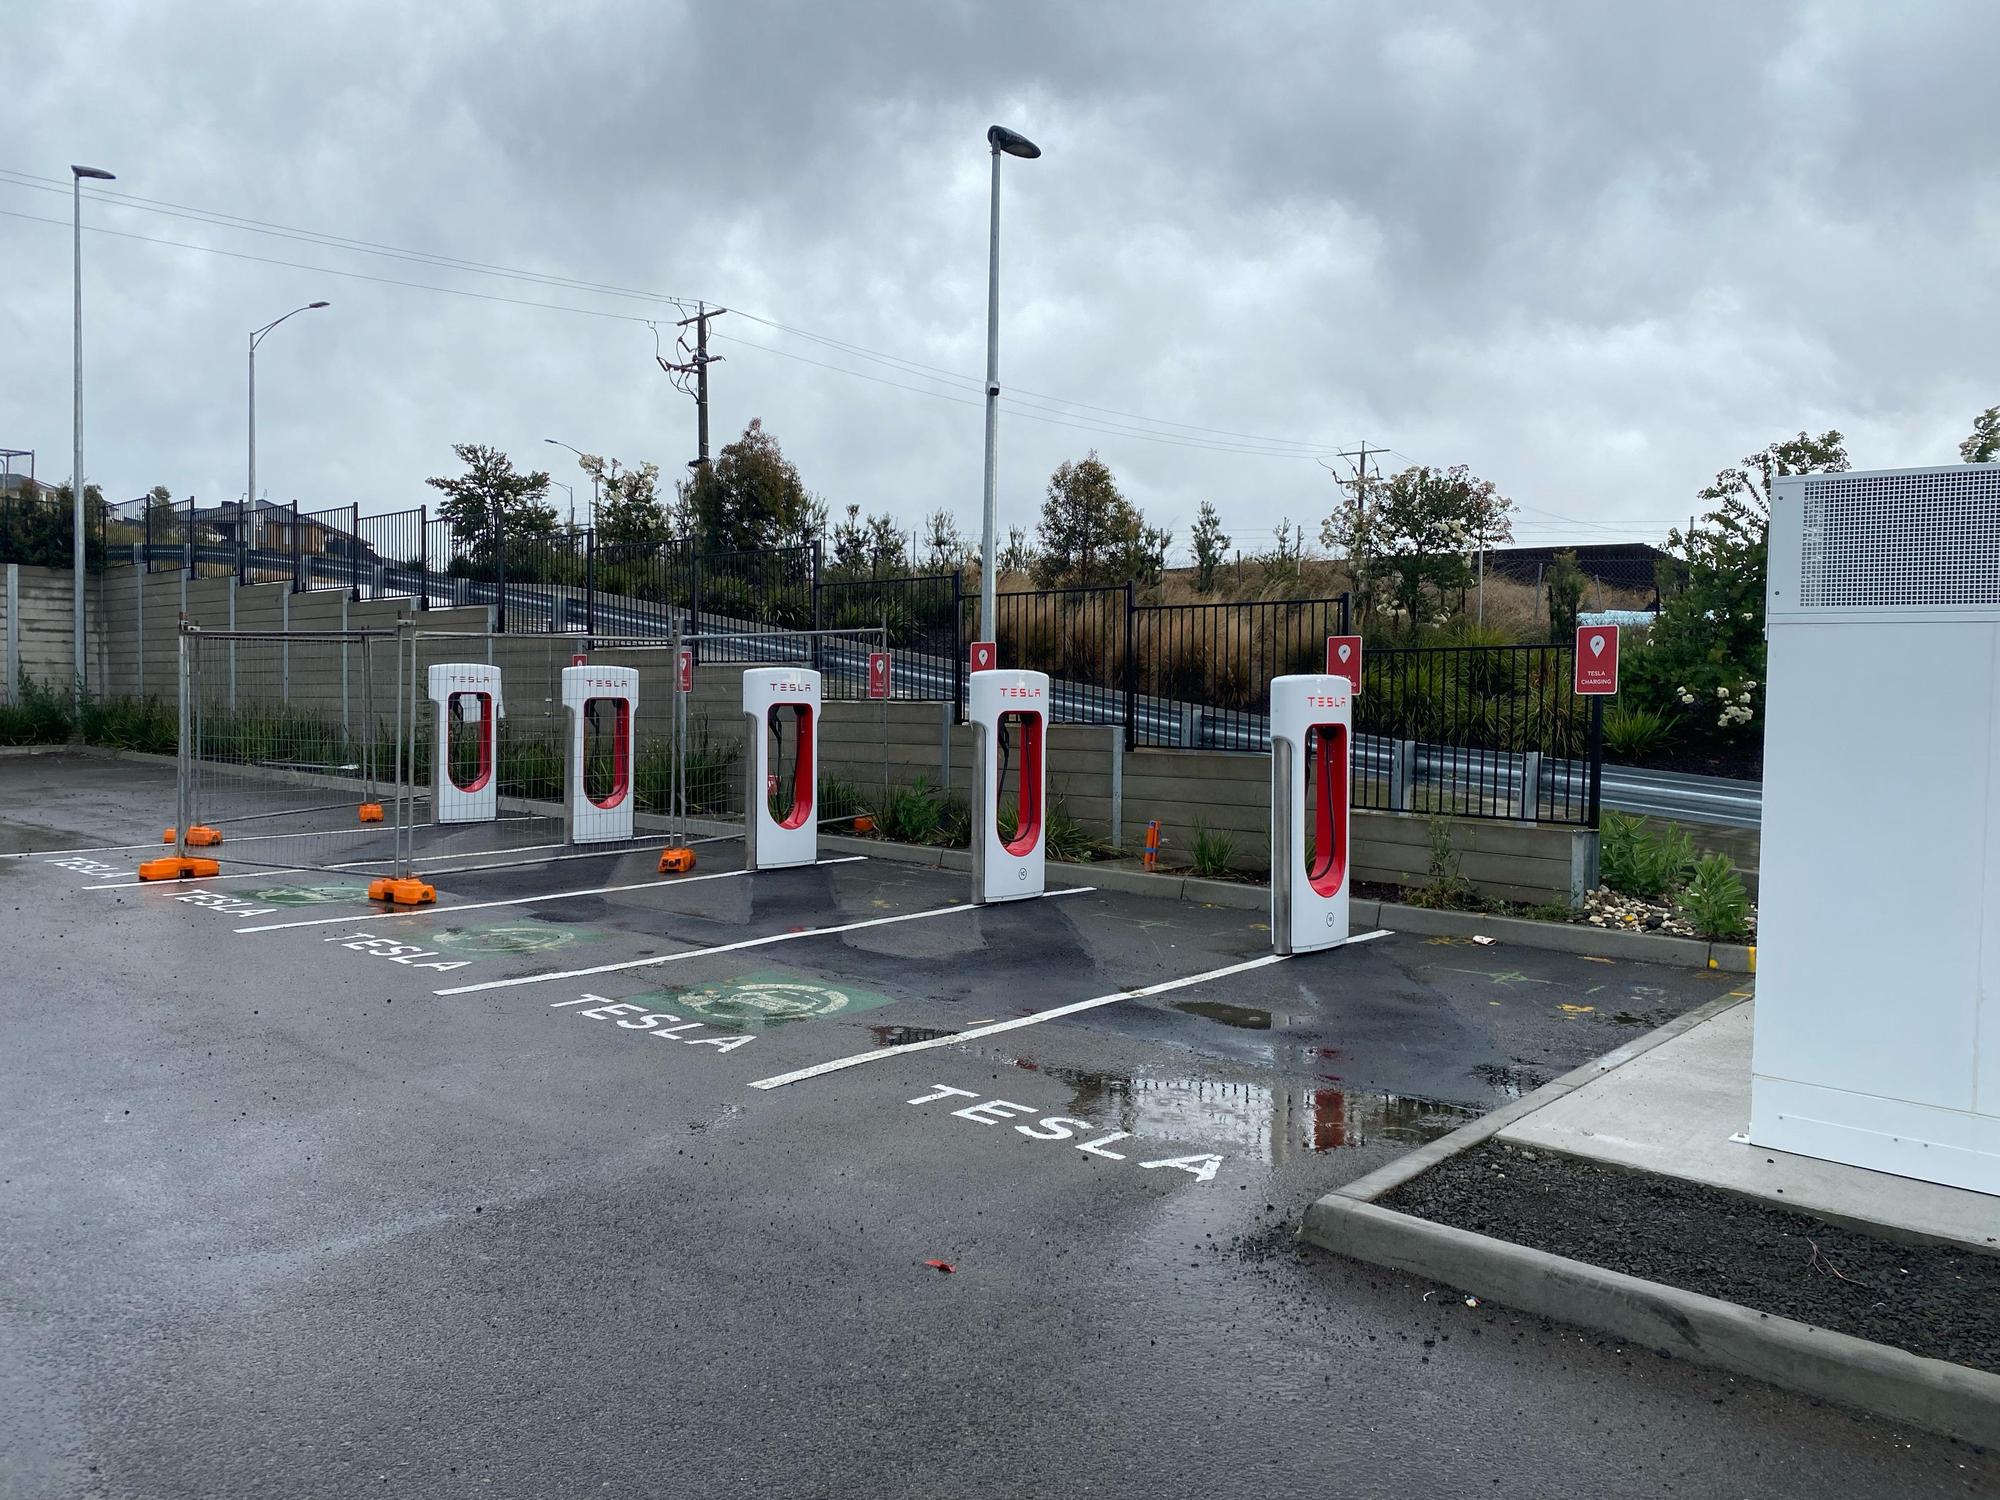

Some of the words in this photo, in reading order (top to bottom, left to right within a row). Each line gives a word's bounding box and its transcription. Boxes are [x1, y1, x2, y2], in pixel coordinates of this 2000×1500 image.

[586, 679, 628, 687] TESLA
[770, 683, 812, 692] TESLA
[1000, 687, 1041, 697] TESLA
[1307, 696, 1347, 707] TESLA
[43, 857, 137, 879] TESLA
[162, 889, 278, 918] TESLA
[324, 932, 472, 972] TESLA
[550, 993, 757, 1053] TESLA
[906, 1083, 1224, 1182] TESLA
